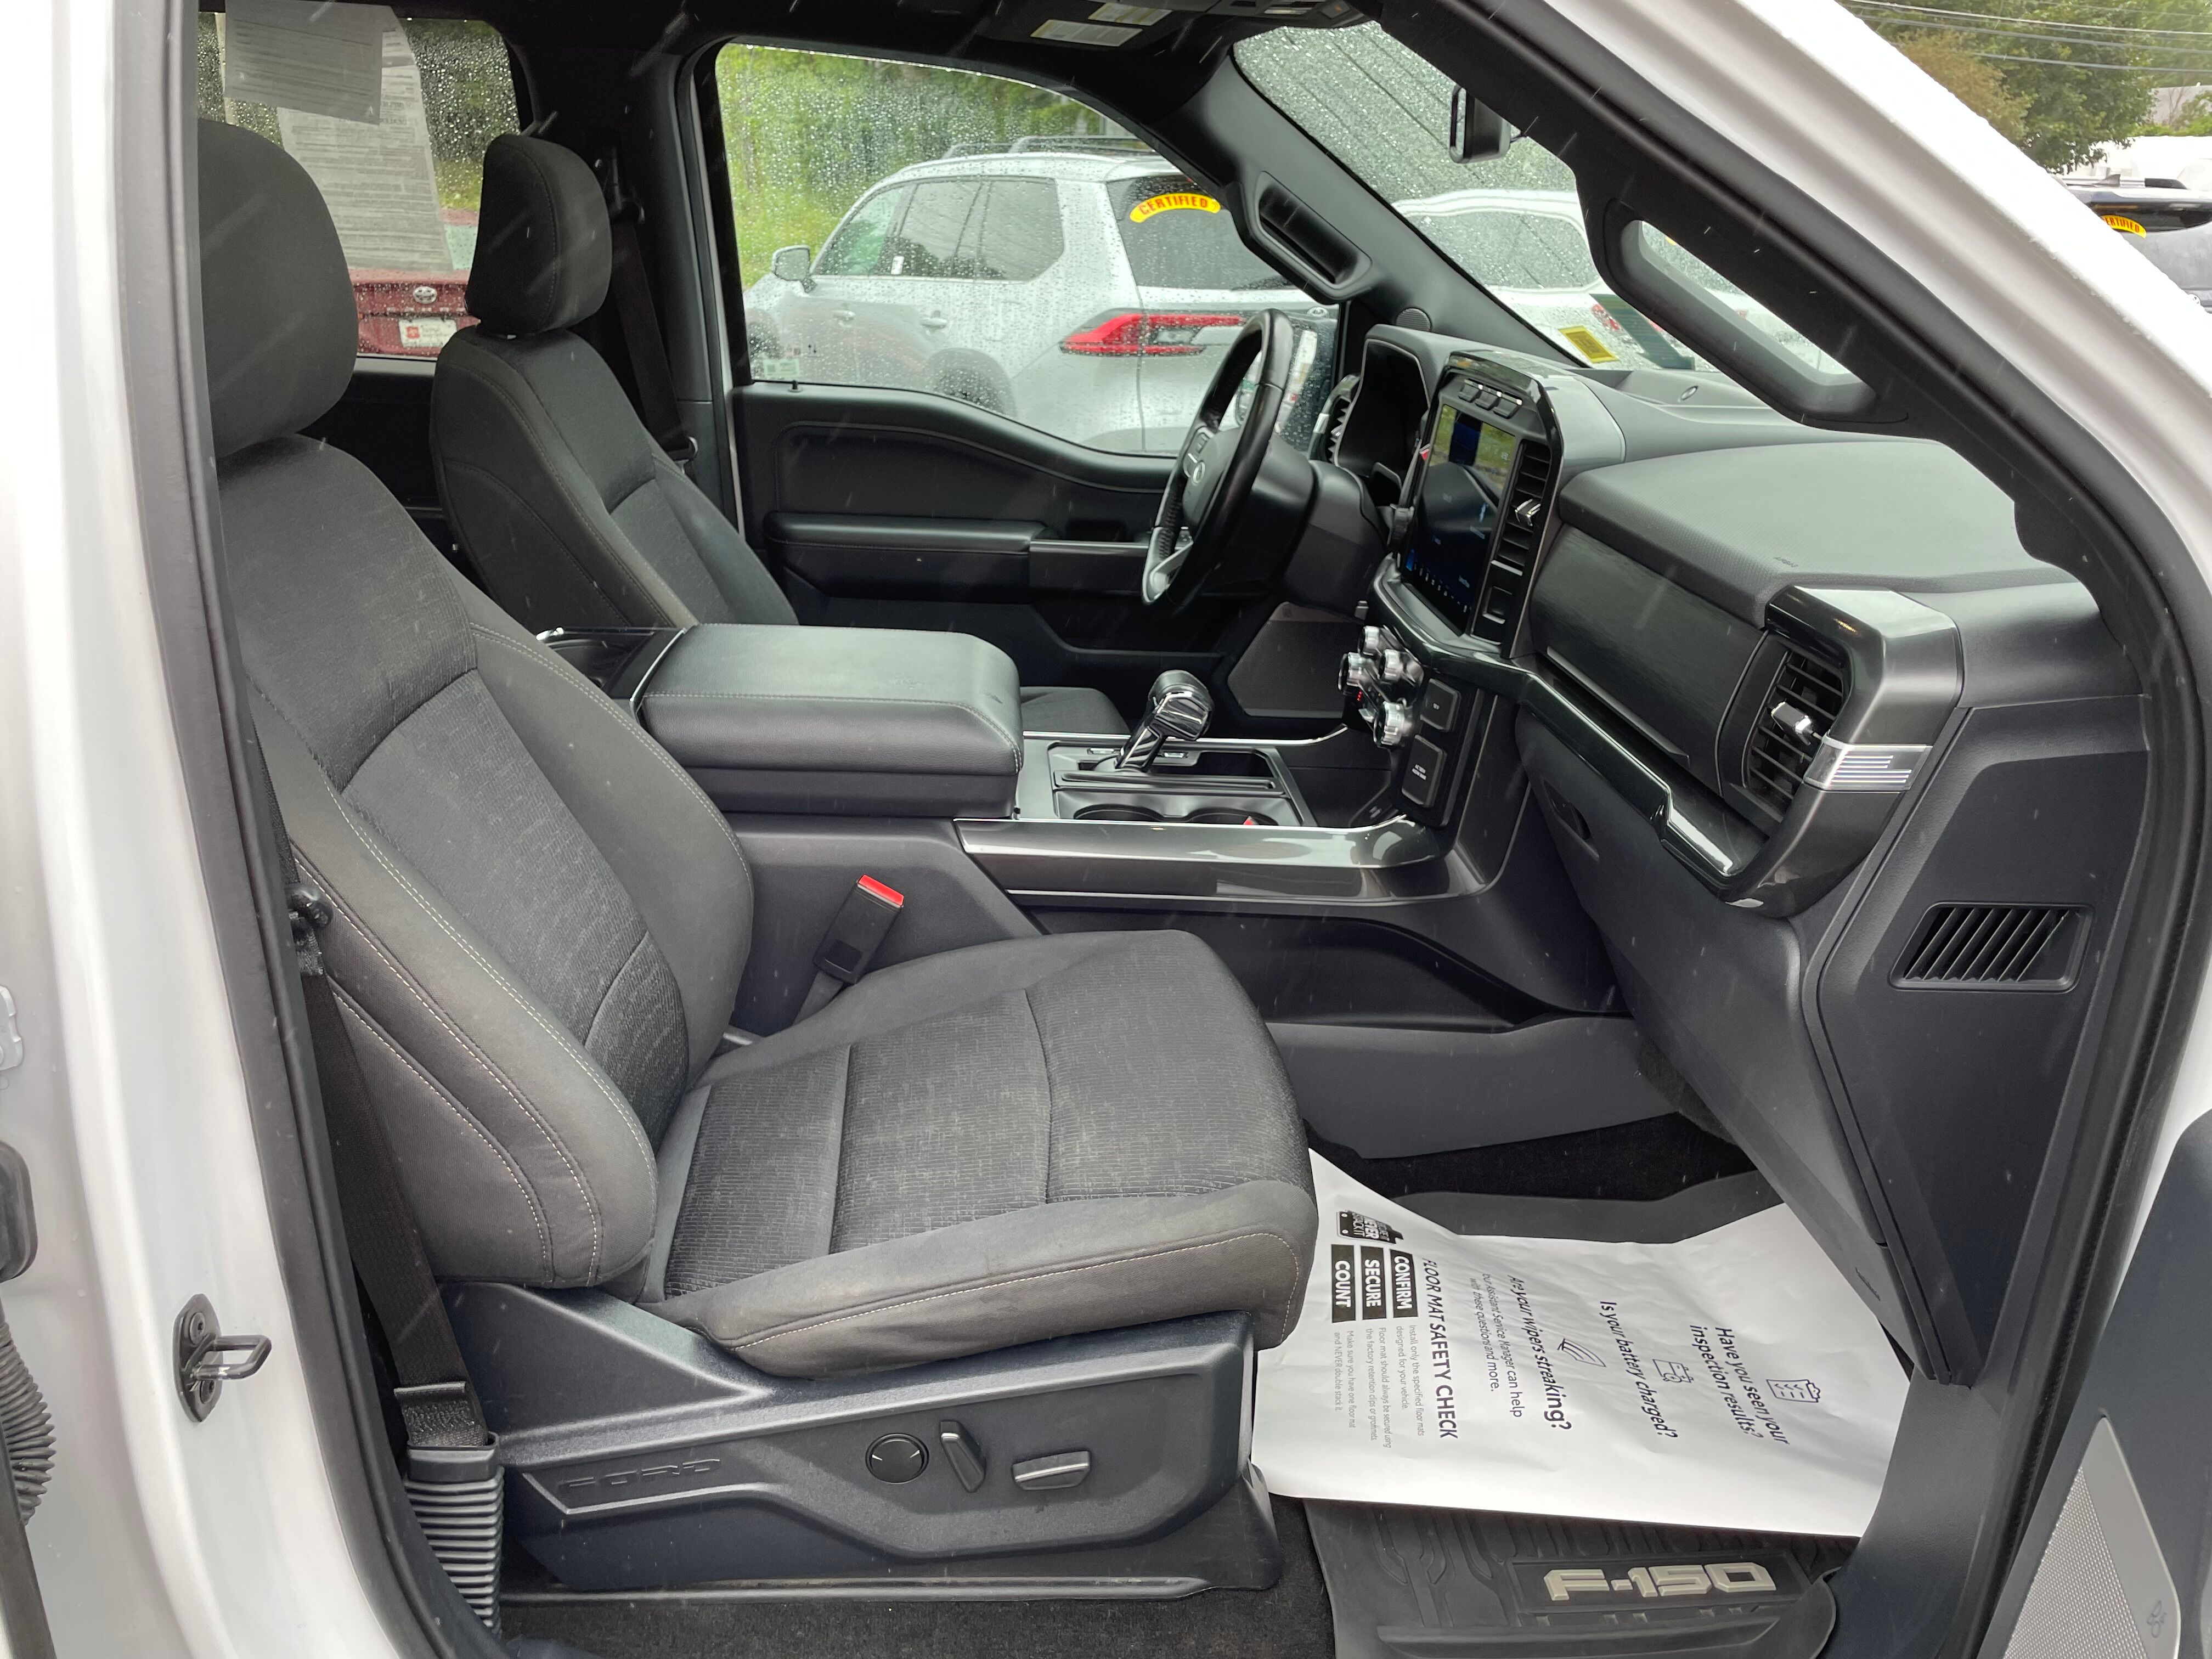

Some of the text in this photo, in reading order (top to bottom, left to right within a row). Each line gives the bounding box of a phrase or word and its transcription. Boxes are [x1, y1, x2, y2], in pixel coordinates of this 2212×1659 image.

[1138, 195, 1209, 215] CERTIFIED
[1334, 1260, 1350, 1307] COUNT
[1365, 1259, 1381, 1307] SECURE
[1393, 1256, 1412, 1309] CONFIRM
[1472, 1291, 1484, 1310] these
[1486, 1285, 1501, 1313] Assistant
[1379, 1328, 1387, 1344] Floor
[1408, 1325, 1417, 1344] Install
[1475, 1311, 1492, 1345] questions
[1493, 1313, 1506, 1339] Service
[1347, 1330, 1355, 1347] Make
[1395, 1326, 1406, 1357] designed
[1423, 1259, 1458, 1438] FLOOR MAT SAFETY CHECK
[1365, 1341, 1375, 1364] factory
[1409, 1346, 1418, 1360] only
[1484, 1346, 1498, 1360] and
[1498, 1340, 1516, 1369] Manager
[1508, 1275, 1572, 1430] Are your wipers streaking?
[1335, 1368, 1343, 1389] double
[1345, 1364, 1354, 1376] you
[1368, 1365, 1376, 1393] retention
[1381, 1360, 1389, 1383] should
[1397, 1369, 1407, 1385] your
[1487, 1362, 1499, 1392] more.
[1507, 1371, 1519, 1387] can
[1599, 1301, 1678, 1438] Is your battery charged?
[1690, 1325, 1764, 1438] inspection results?
[1335, 1391, 1344, 1404] stack
[1380, 1384, 1390, 1404] always
[1412, 1376, 1422, 1406] specified
[1716, 1327, 1790, 1444] Have you seen your
[1368, 1395, 1377, 1407] clips
[1510, 1392, 1525, 1418] help
[1383, 1414, 1391, 1434] secured
[1383, 1435, 1392, 1448] using
[1543, 1561, 1777, 1601] F-150
